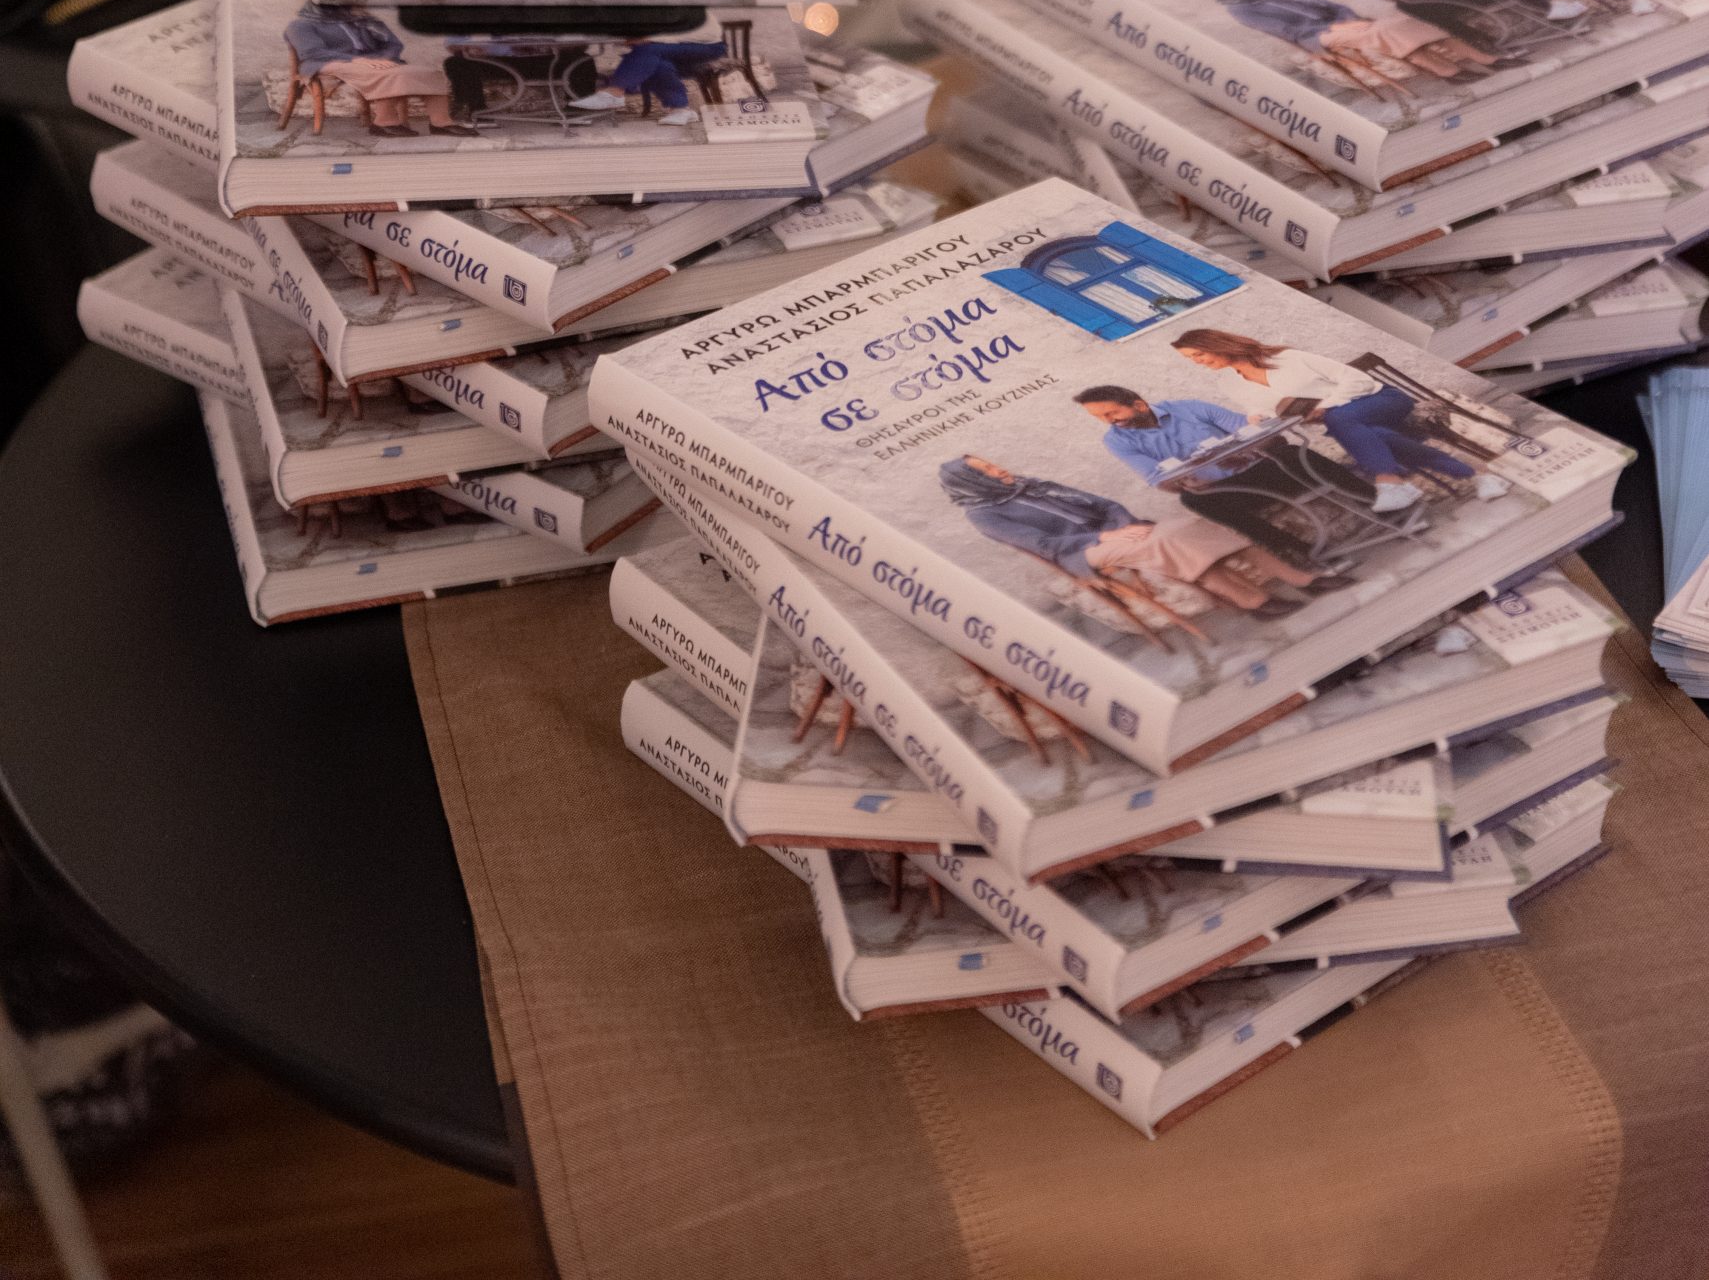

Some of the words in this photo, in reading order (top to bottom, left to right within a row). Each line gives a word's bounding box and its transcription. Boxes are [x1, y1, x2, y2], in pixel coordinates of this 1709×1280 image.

[1107, 10, 1150, 49] Από
[1154, 42, 1216, 87] στόμα
[1225, 79, 1249, 104] σε
[1257, 99, 1322, 143] στόμα
[1062, 88, 1108, 127] Από
[1110, 121, 1170, 168] στόμα
[1177, 160, 1202, 187] σε
[1208, 179, 1273, 228] στόμα
[386, 221, 413, 248] σε
[420, 239, 489, 285] στόμα
[680, 314, 780, 360] ΑΡΓΥΡΩ
[782, 234, 971, 317] ΜΠΑΡΜΠΑΡΙΓΟΥ
[706, 303, 868, 375] ΑΝΑΣΤΑΣΙΟΣ
[867, 227, 1048, 307] ΠΑΠΑΛΑΖΑΡΟΥ
[421, 365, 486, 410] στόμα
[754, 352, 849, 412] Από
[863, 296, 998, 362] στόμα
[820, 397, 880, 432] σε
[890, 333, 1026, 401] στόμα
[635, 407, 686, 448] ΑΡΓΥΡΩ
[688, 439, 796, 512] ΜΠΑΡΜΠΑΡΙΓΟΥ
[855, 403, 948, 450] ΘΗΣΑΥΡΟΙ
[946, 388, 983, 408] ΤΗΣ
[873, 412, 975, 461] ΕΛΛΗΝΙΚΗΣ
[976, 372, 1061, 416] ΚΟΥΖΙΝΑΣ
[607, 414, 687, 472] ΑΝΑΣΤΑΣΙΟΣ
[690, 464, 791, 534] ΠΑΠΑΛΑΖΑΡΟΥ
[687, 493, 761, 575] ΜΠΑΡΜΠΑΡΙΓΟΥ
[628, 616, 698, 678] ΑΝΑΣΤΑΣΙΟΣ
[651, 613, 695, 655] ΑΡΓΥΡΩ
[807, 516, 867, 568] Από
[871, 560, 953, 623] στόμα
[963, 616, 997, 650] σε
[1004, 641, 1091, 708] στόμα
[768, 585, 810, 638] Από
[812, 635, 867, 706] στόμα
[874, 703, 898, 739] σε
[903, 734, 966, 809] στόμα
[639, 738, 712, 800] ΑΝΑΣΤΑΣΙΟΣ
[664, 735, 711, 777] ΑΡΓΥΡΩ
[972, 877, 1047, 949] στόμα
[1002, 1003, 1081, 1067] στόμα
